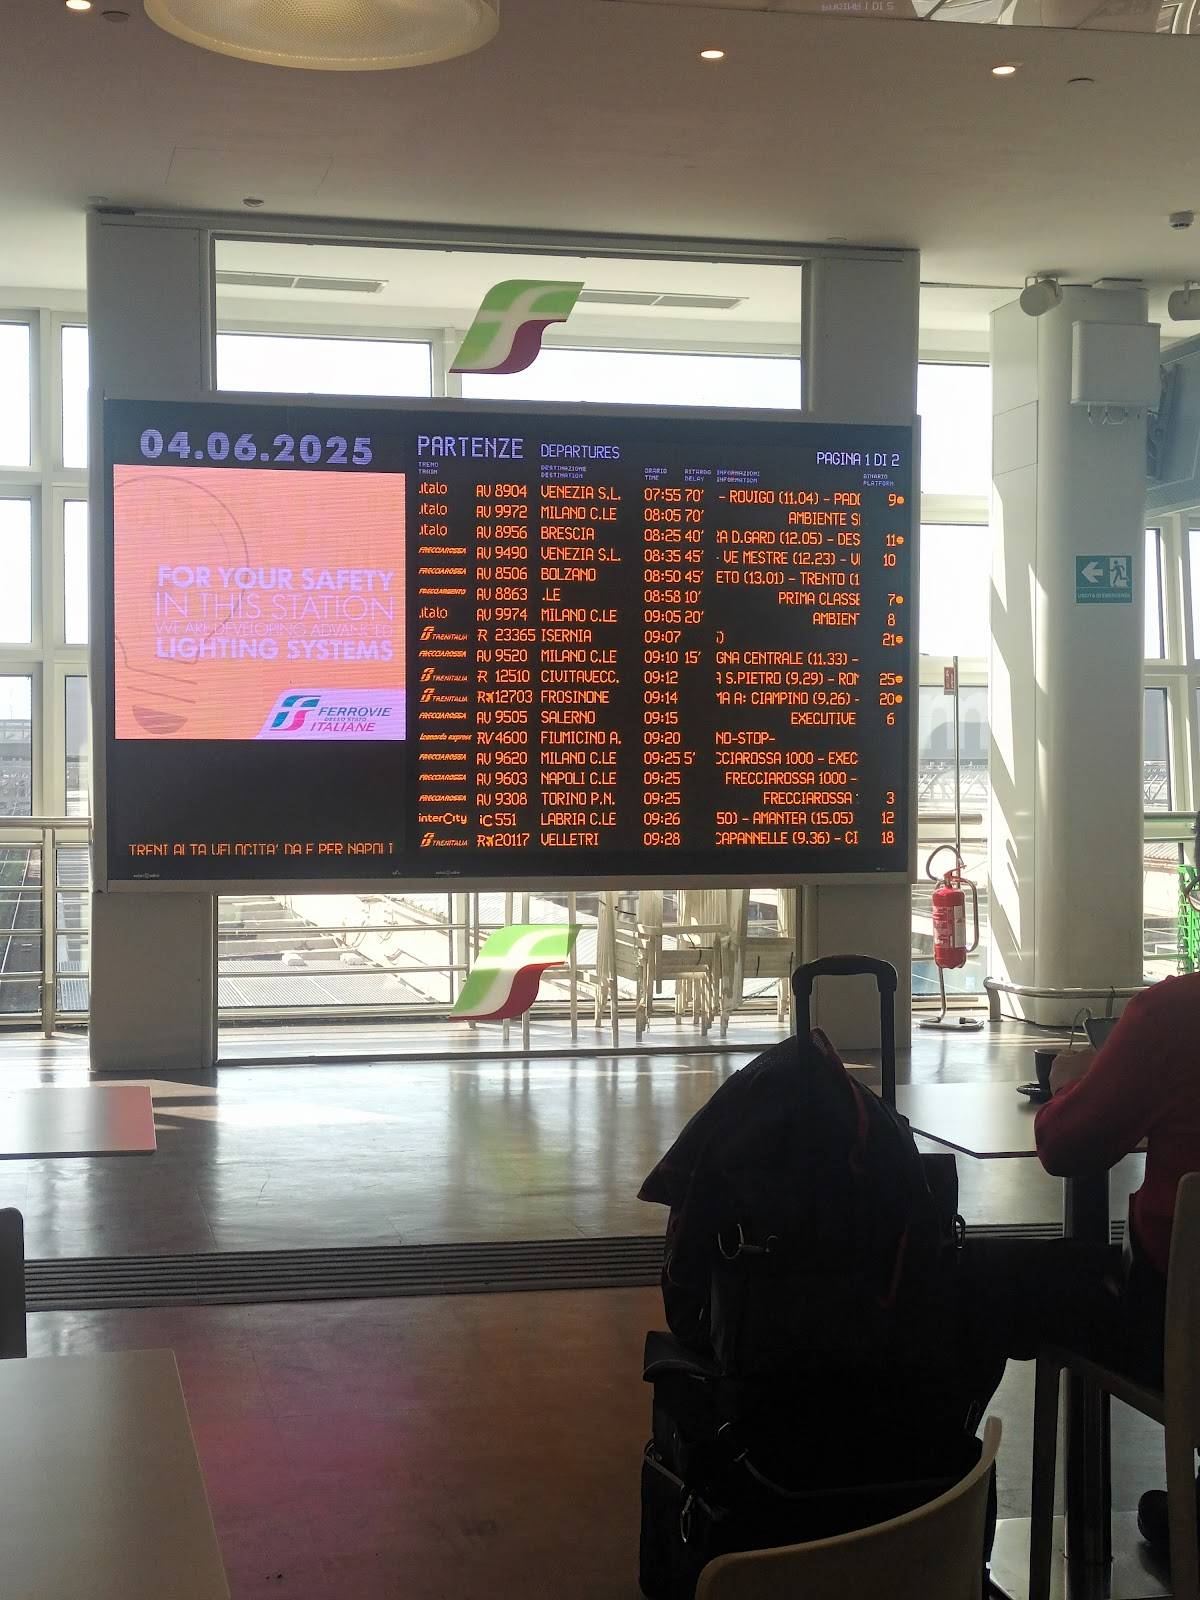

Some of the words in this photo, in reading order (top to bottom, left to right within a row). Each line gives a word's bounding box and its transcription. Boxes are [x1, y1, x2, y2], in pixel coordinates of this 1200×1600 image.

[140, 429, 372, 465] 04.06.2025
[417, 435, 523, 458] PARTENZE
[540, 444, 620, 459] DEPARTURES
[816, 451, 861, 466] PAGINA
[865, 453, 870, 466] 1
[874, 453, 887, 466] DI
[891, 454, 900, 467] 2
[476, 485, 491, 497] AV
[495, 484, 527, 498] 8904
[541, 485, 594, 499] VENEZIA
[599, 487, 621, 500] S.L.
[644, 488, 681, 501] 07:55
[730, 490, 774, 503] ROVIGO
[779, 491, 818, 504] (11.04)
[889, 494, 896, 506] 9
[477, 506, 491, 518] AV
[495, 505, 527, 518] 9972
[541, 506, 586, 519] MILANO
[590, 507, 616, 520] C.LE
[645, 508, 681, 522] 08:05
[789, 512, 847, 525] AMBIENTE
[495, 525, 527, 539] 8956
[541, 526, 594, 540] BRESCIA
[644, 529, 681, 542] 08:25
[732, 530, 775, 544] D.GARD
[780, 532, 822, 544] (12.05)
[886, 534, 896, 547] 11
[495, 546, 527, 559] 9490
[541, 547, 594, 560] VENEZIA
[644, 549, 681, 562] 08:35
[743, 551, 788, 564] MESTRE
[793, 552, 835, 565] (12.23)
[884, 554, 896, 566] 10
[157, 565, 211, 588] FOR
[218, 566, 293, 590] YOUR
[301, 568, 394, 592] SAFETY
[495, 567, 527, 580] 8506
[541, 568, 596, 581] BOLZANO
[644, 569, 681, 582] 08:50
[744, 571, 784, 584] (13.01)
[800, 572, 845, 585] TRENTO
[495, 587, 527, 600] 8863
[543, 588, 560, 601] .LE
[644, 590, 681, 603] 08:58
[779, 592, 816, 604] PRIMA
[889, 594, 896, 606] 7
[155, 591, 188, 617] IN
[200, 592, 261, 619] THIS
[271, 593, 393, 621] STATION
[495, 608, 527, 621] 9974
[541, 608, 586, 622] MILANO
[590, 609, 617, 622] C.LE
[644, 610, 681, 623] 09:05
[888, 613, 895, 626] 8
[495, 628, 535, 641] 23365
[541, 629, 591, 642] ISERNIA
[645, 630, 681, 643] 09:07
[883, 633, 896, 646] 21
[155, 637, 279, 660] LIGHTING
[287, 639, 393, 661] SYSTEMS
[495, 649, 527, 662] 9520
[541, 650, 586, 662] MILANO
[590, 650, 616, 663] C.LE
[645, 650, 678, 663] 09:10
[744, 652, 803, 664] CENTRALE
[808, 652, 847, 665] (11.33)
[496, 669, 530, 682] 12510
[541, 670, 619, 683] CIVITAVECC.
[644, 671, 678, 684] 09:12
[726, 672, 781, 685] S.PIETRO
[786, 672, 823, 685] (9.29)
[880, 673, 896, 685] 25
[495, 690, 532, 703] 12703
[541, 690, 609, 703] FROSINONE
[644, 691, 678, 704] 09:14
[752, 692, 808, 704] CIAMPINO
[813, 692, 850, 705] (9.26)
[880, 693, 896, 705] 20
[318, 707, 392, 717] FERROVIE
[495, 710, 527, 723] 9505
[541, 711, 595, 724] SALERNO
[644, 712, 678, 724] 09:15
[791, 712, 856, 724] EXECUTIVE
[887, 713, 894, 725] 6
[310, 722, 376, 732] ITALIANE
[495, 731, 527, 744] 4600
[541, 731, 605, 744] FIUMICINO
[644, 732, 680, 744] 09:20
[716, 732, 775, 744] NO-STOP-
[495, 752, 527, 764] 9620
[541, 752, 585, 764] MILANO
[644, 752, 680, 764] 09:25
[495, 772, 527, 785] 9603
[541, 772, 585, 784] NAPOLI
[644, 772, 680, 784] 09:25
[726, 772, 814, 784] FRECCIAROSSA
[495, 792, 527, 805] 9308
[541, 792, 586, 805] TORINO
[591, 792, 615, 805] P.N.
[644, 792, 680, 804] 09:25
[764, 792, 852, 804] FRECCIAROSSA
[887, 792, 894, 804] 3
[495, 813, 516, 826] 551
[541, 813, 585, 825] LABRIA
[644, 812, 680, 825] 09:26
[753, 812, 806, 824] AMANTEA
[811, 812, 853, 824] (15.05)
[882, 812, 894, 824] 12
[495, 833, 529, 847] 20117
[541, 833, 598, 846] VELLETRI
[644, 832, 680, 845] 09:28
[793, 832, 830, 844] (9.36)
[882, 831, 894, 844] 18
